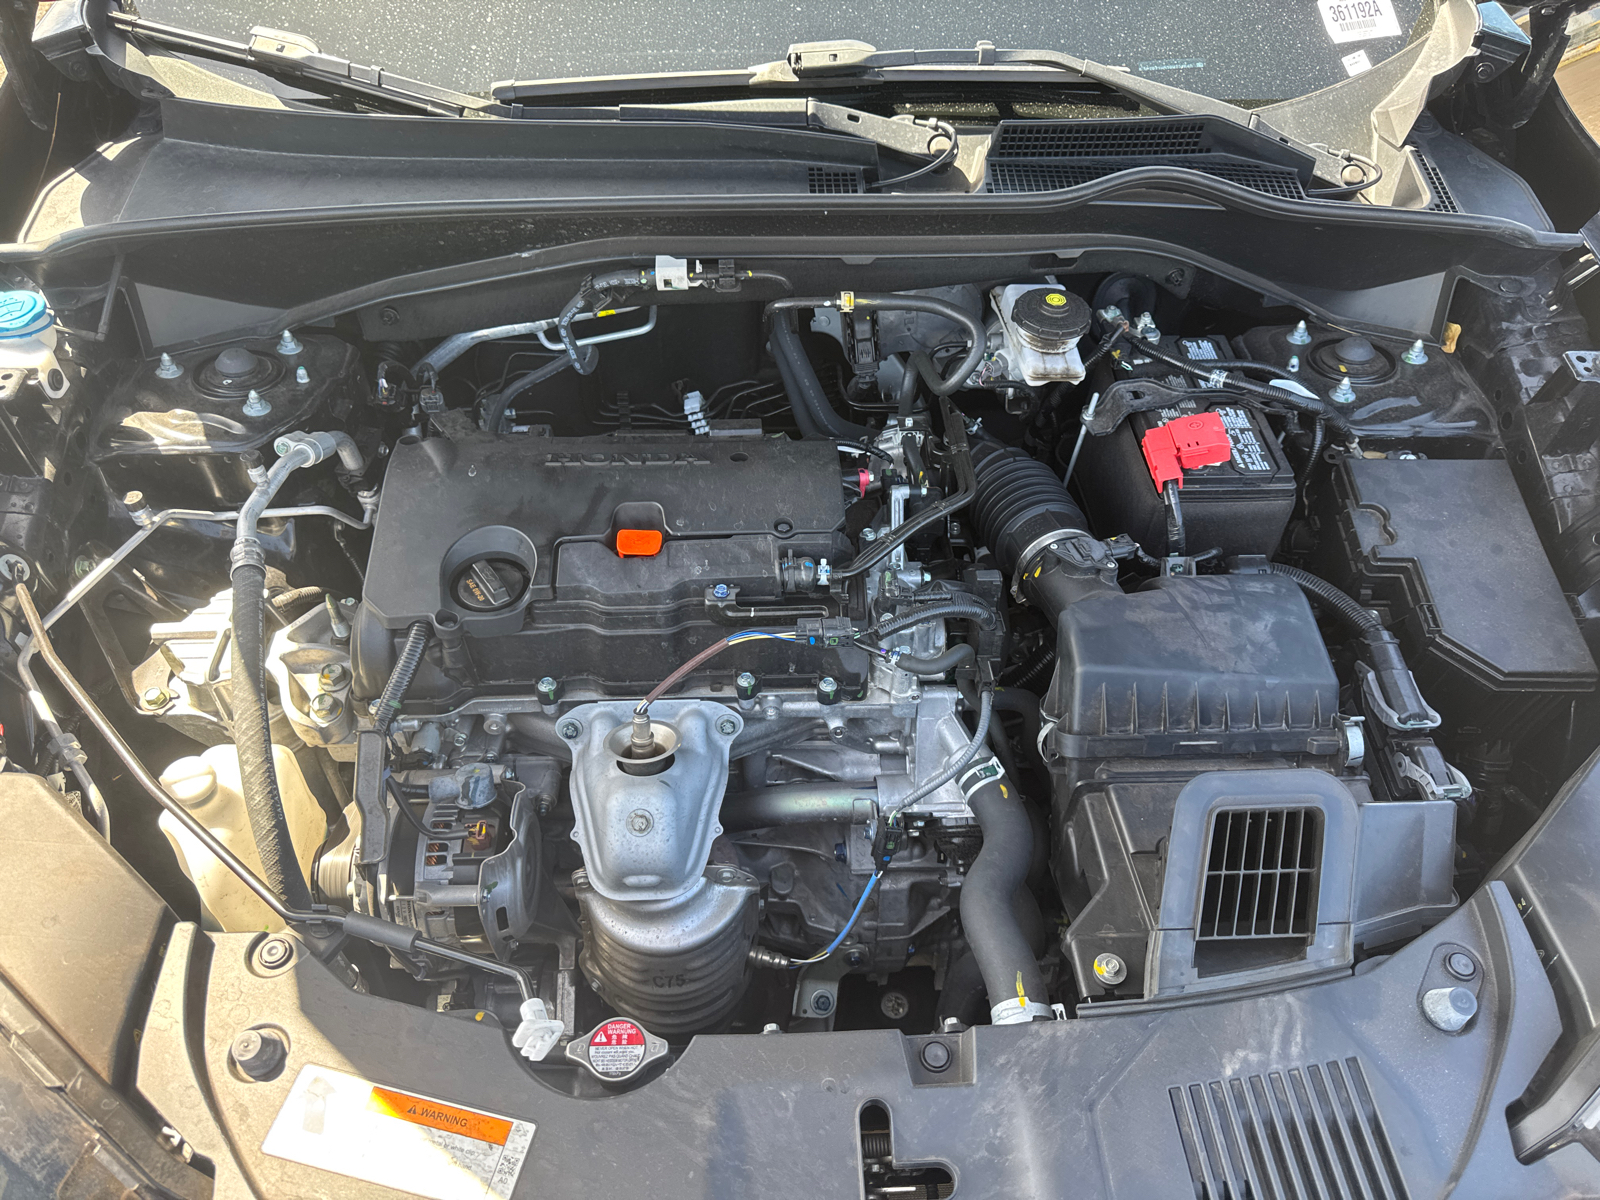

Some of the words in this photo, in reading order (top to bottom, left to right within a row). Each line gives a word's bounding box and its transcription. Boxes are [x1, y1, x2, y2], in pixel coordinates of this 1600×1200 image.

[1329, 0, 1383, 22] 361192A
[545, 453, 711, 466] HONDA
[466, 579, 476, 589] SAE
[420, 1107, 468, 1128] WARNING
